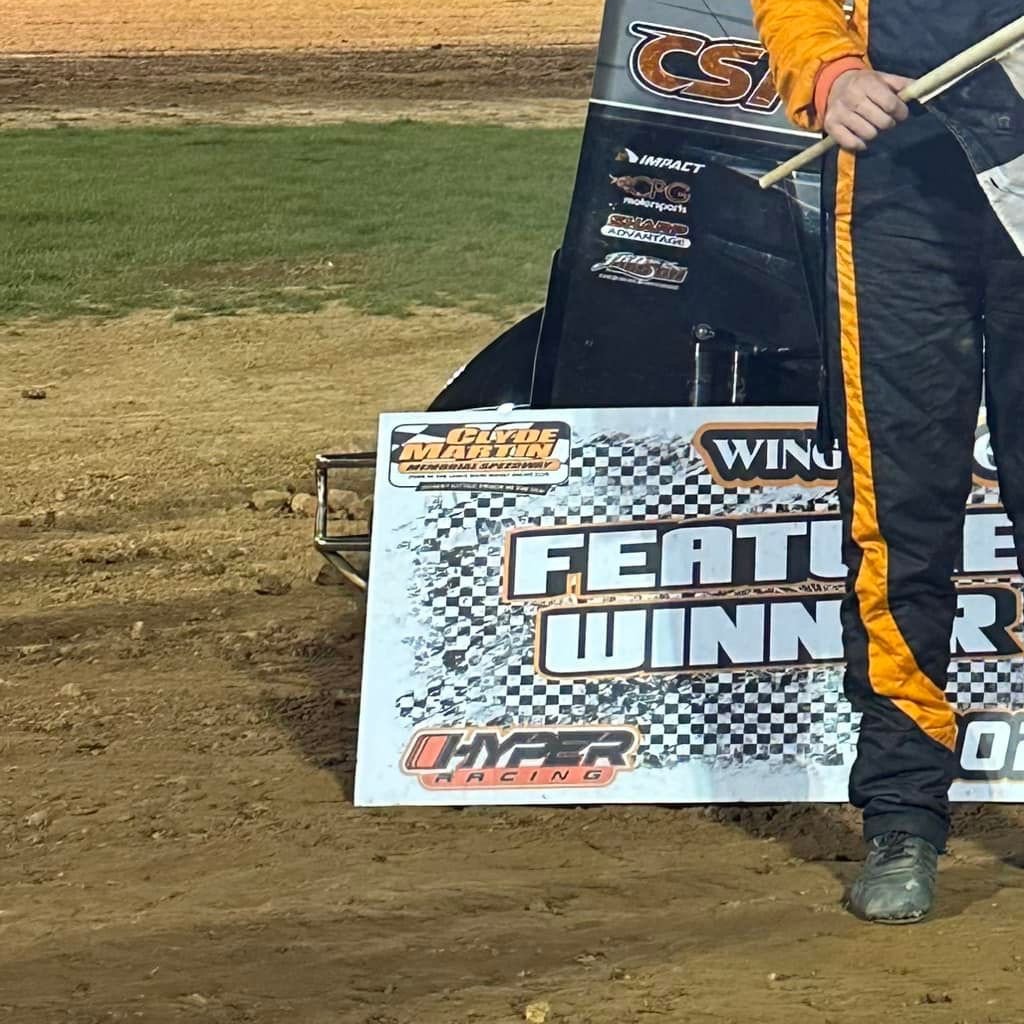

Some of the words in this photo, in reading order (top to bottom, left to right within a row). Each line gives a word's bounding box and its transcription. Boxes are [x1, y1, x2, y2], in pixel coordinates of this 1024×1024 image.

[639, 154, 706, 173] IMPACT
[446, 427, 559, 445] CLYDE
[399, 442, 555, 461] MARTIN
[712, 438, 842, 471] WING
[513, 513, 1019, 595] FEATUE
[545, 593, 998, 673] WINNR
[433, 730, 636, 769] HYPER
[434, 769, 603, 784] RACING
